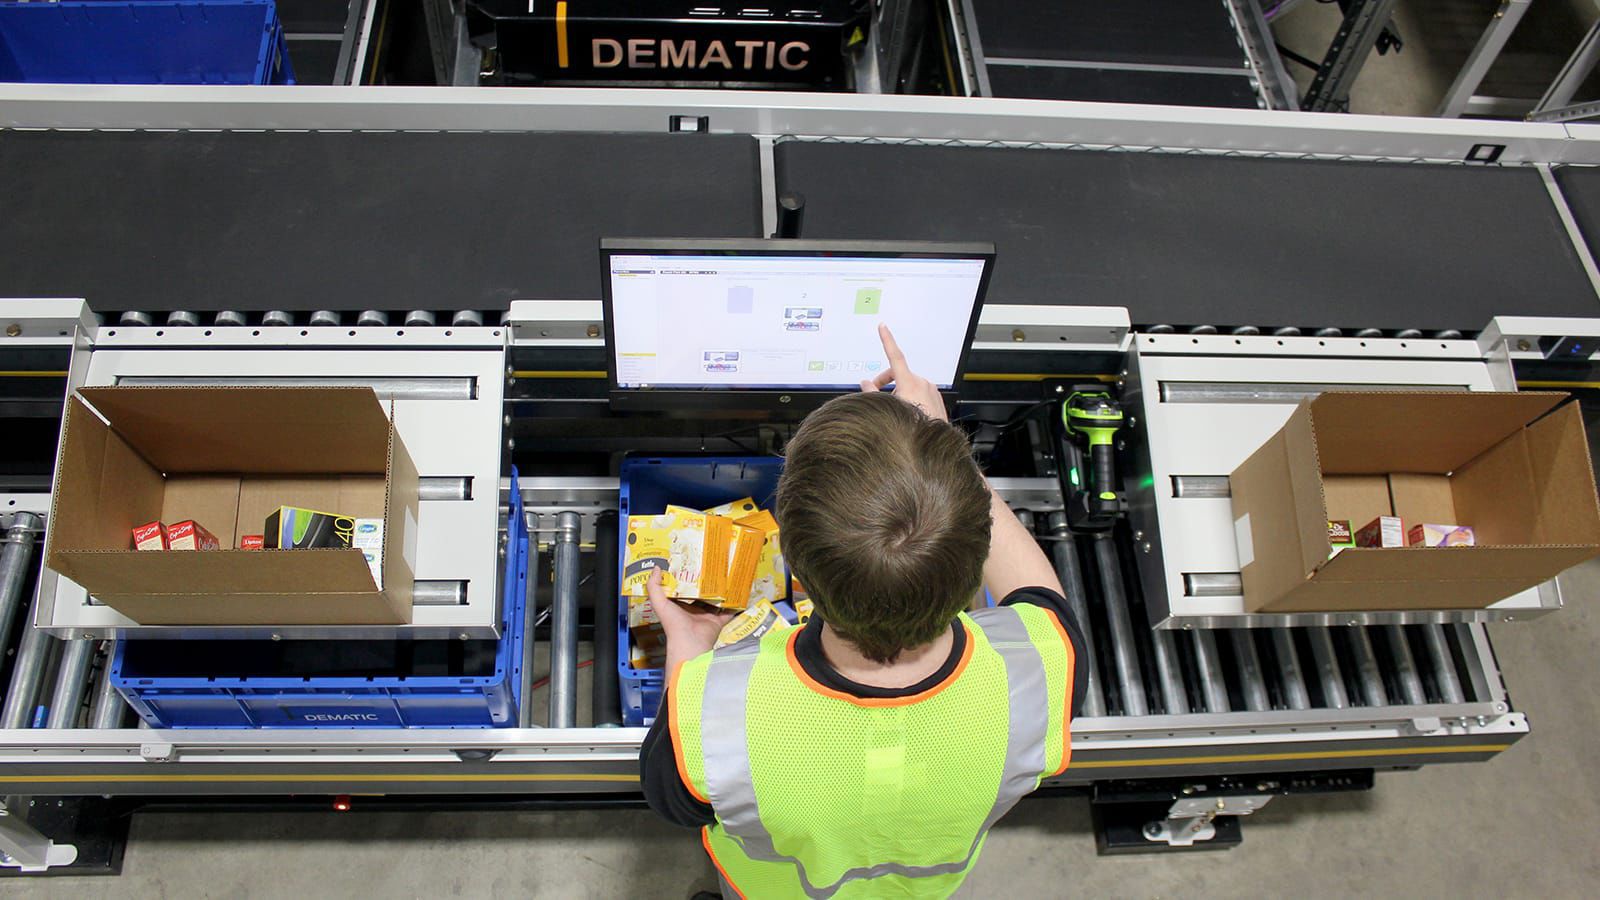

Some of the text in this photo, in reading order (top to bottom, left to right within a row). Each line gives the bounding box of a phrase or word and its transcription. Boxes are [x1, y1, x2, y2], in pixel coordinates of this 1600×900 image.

[591, 38, 811, 71] DEMATIC
[864, 296, 872, 304] 2
[304, 713, 379, 721] DEMATIC
